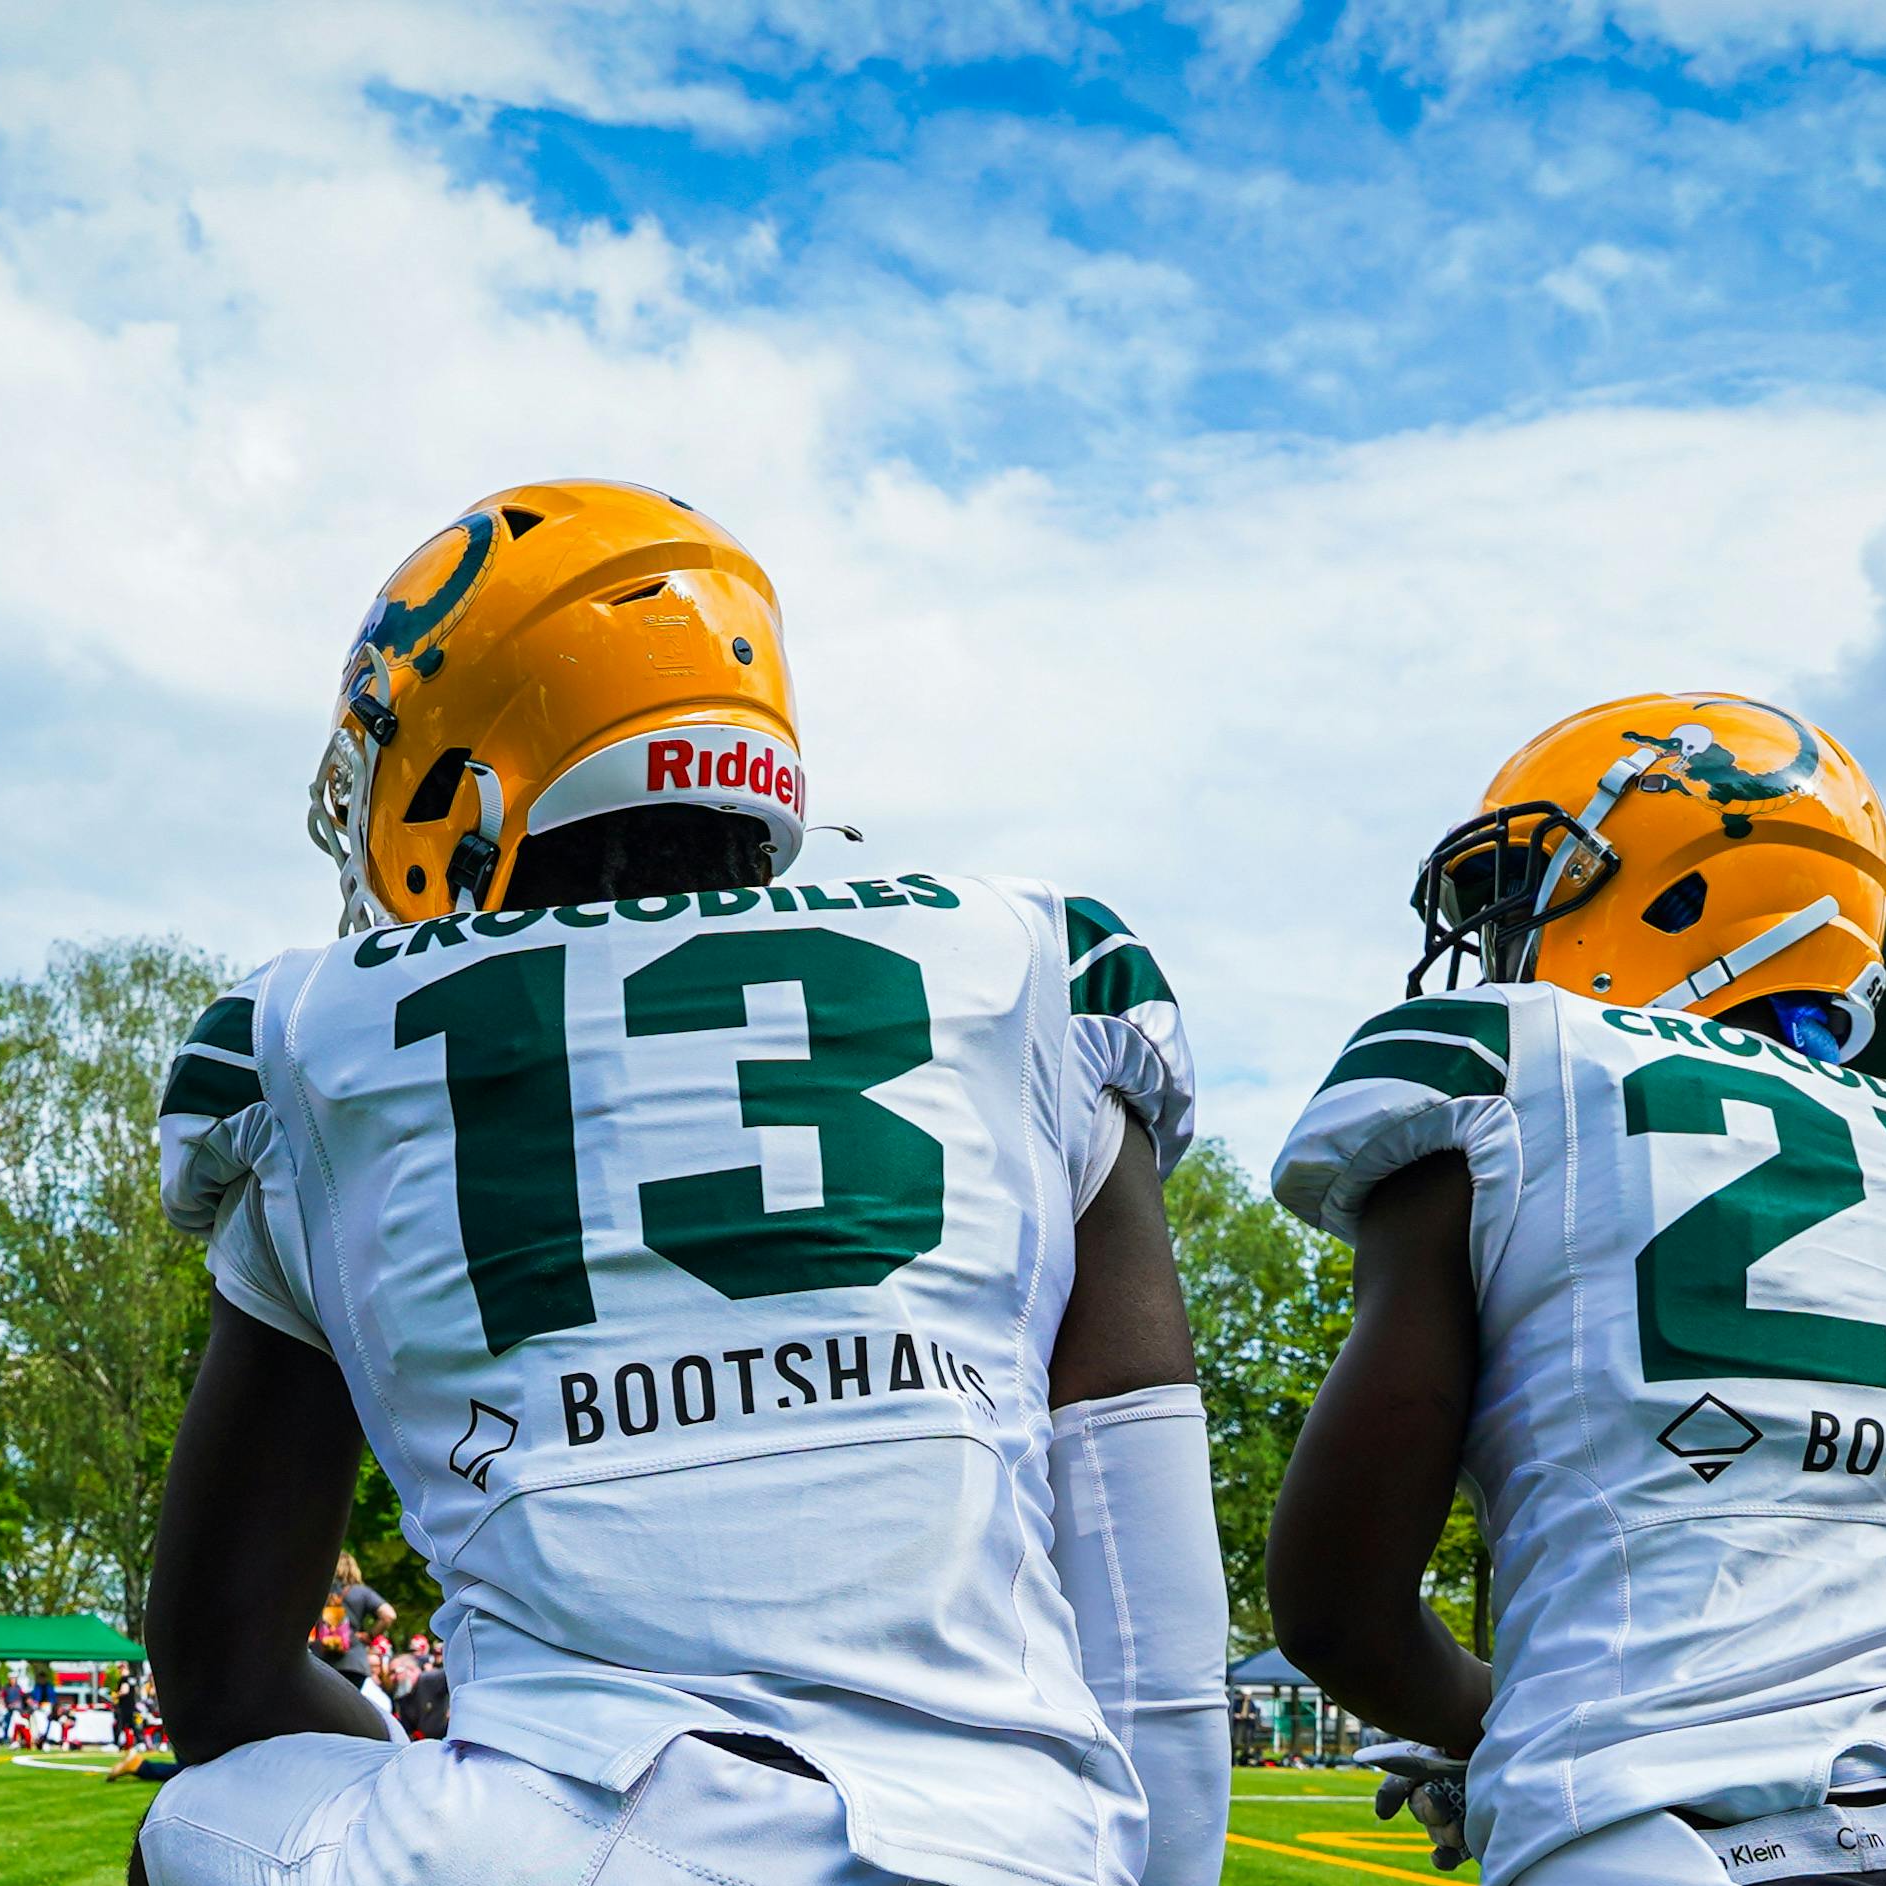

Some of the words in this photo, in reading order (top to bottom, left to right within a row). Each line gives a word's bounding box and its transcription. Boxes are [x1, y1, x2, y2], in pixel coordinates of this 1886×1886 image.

[647, 739, 807, 823] Riddell
[353, 873, 961, 968] CROCODILES
[394, 927, 945, 1358] 13
[1730, 1839, 1786, 1867] Klein
